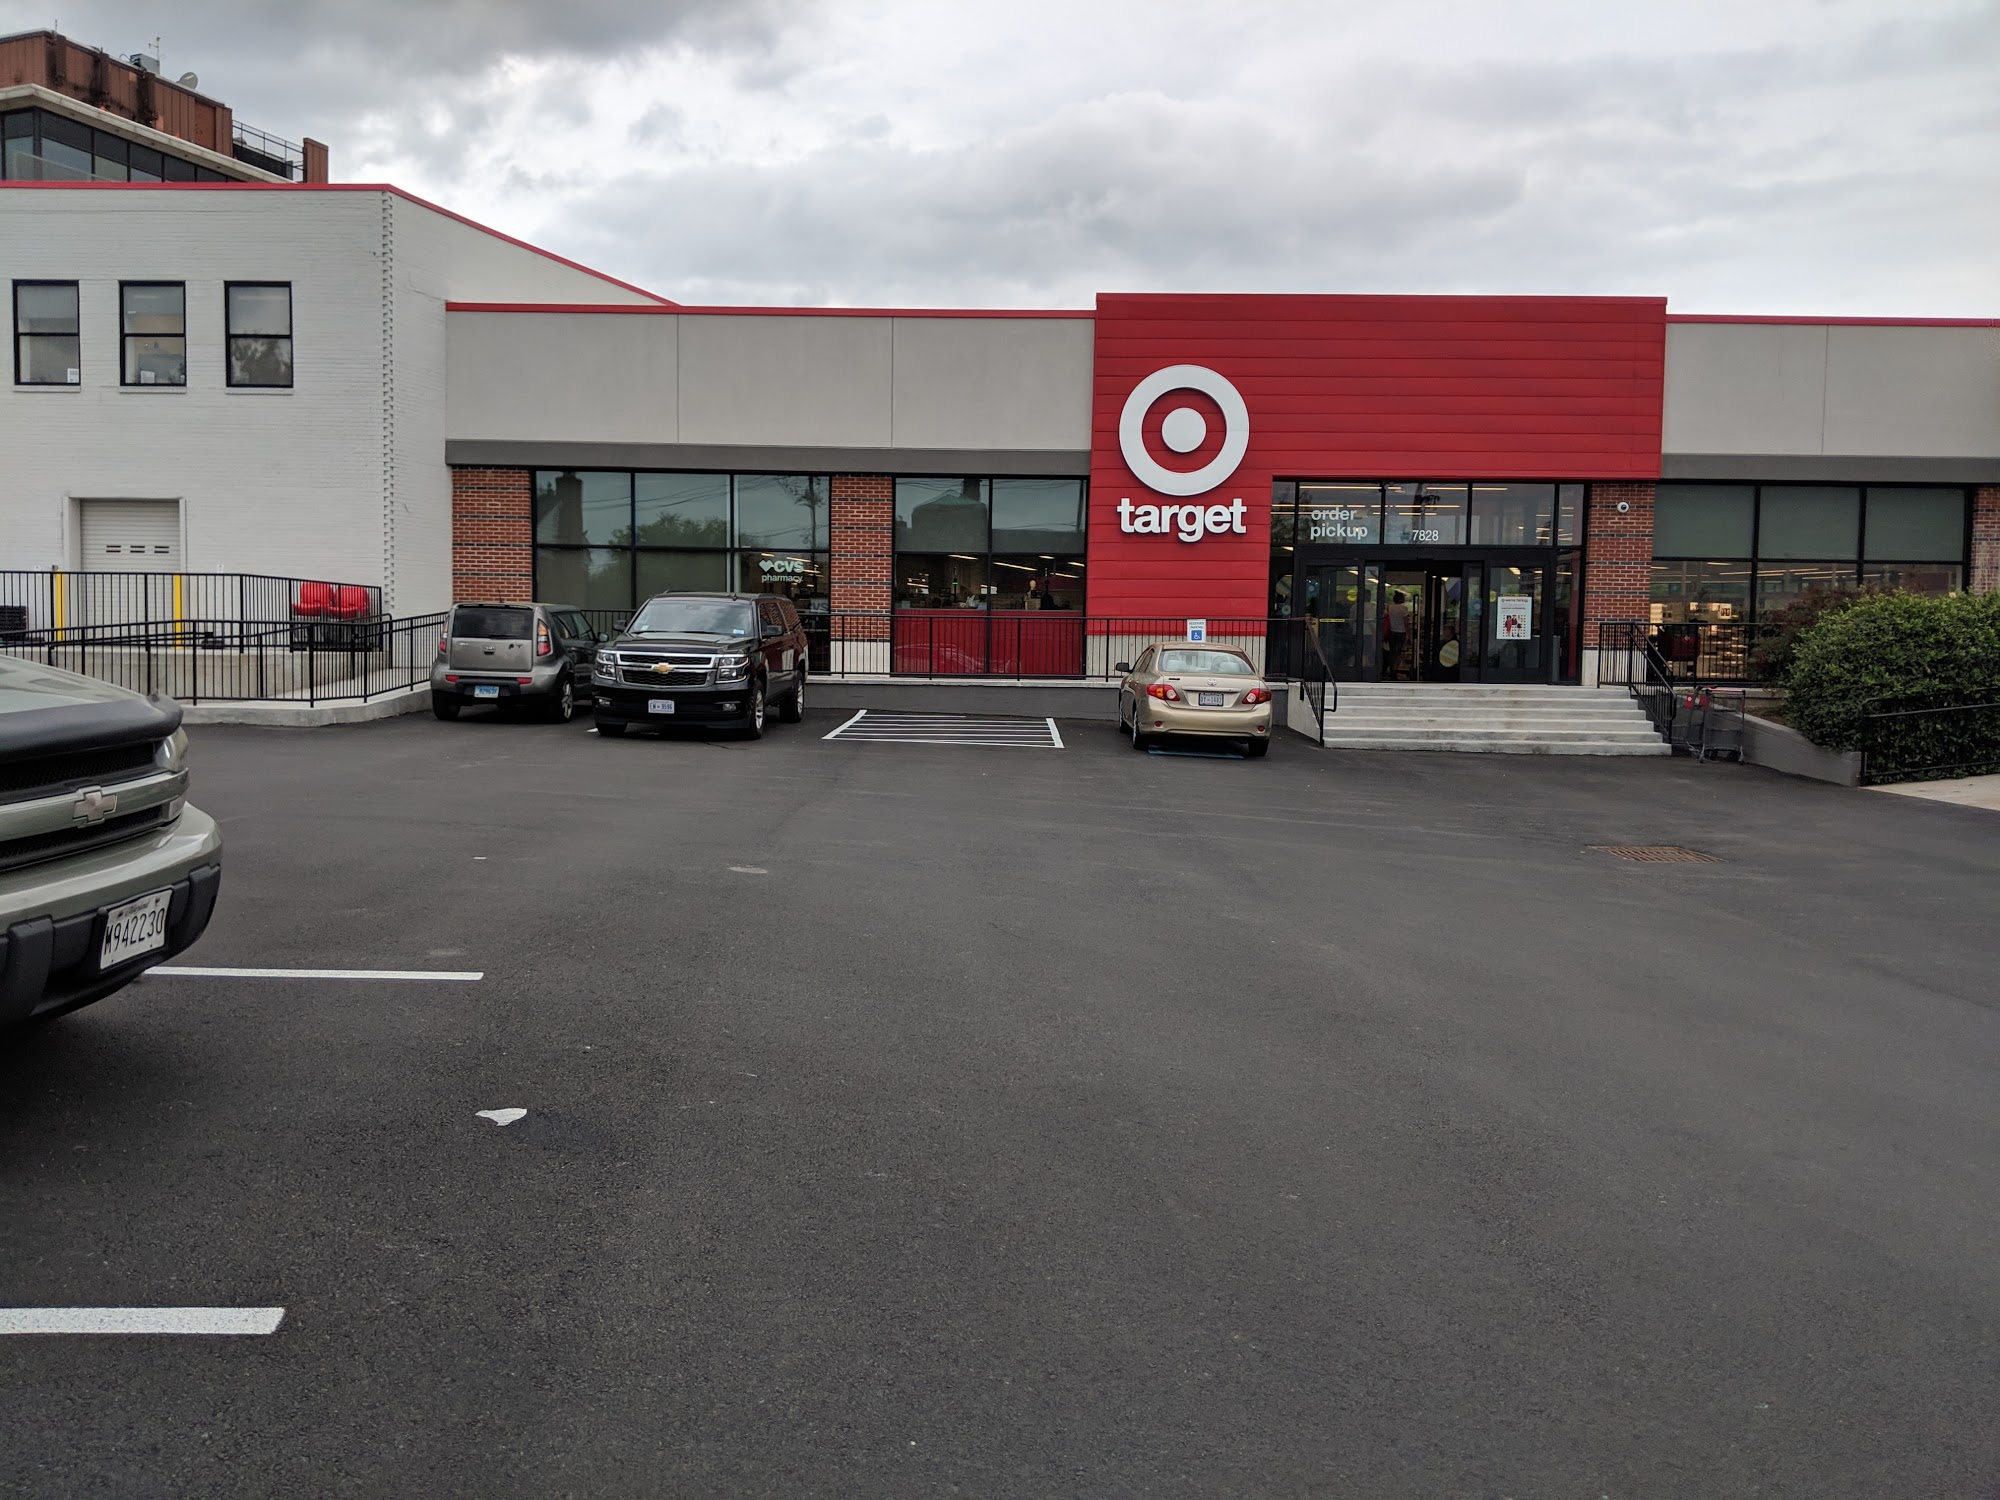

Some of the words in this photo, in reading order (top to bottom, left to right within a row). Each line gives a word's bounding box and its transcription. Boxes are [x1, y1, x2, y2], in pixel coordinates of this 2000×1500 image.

[1117, 498, 1247, 543] target
[1311, 507, 1358, 521] order
[1310, 523, 1368, 540] pickup
[1412, 530, 1439, 541] 7828
[774, 560, 804, 573] CVS
[761, 573, 803, 584] pharmacy
[104, 907, 165, 955] M942230
